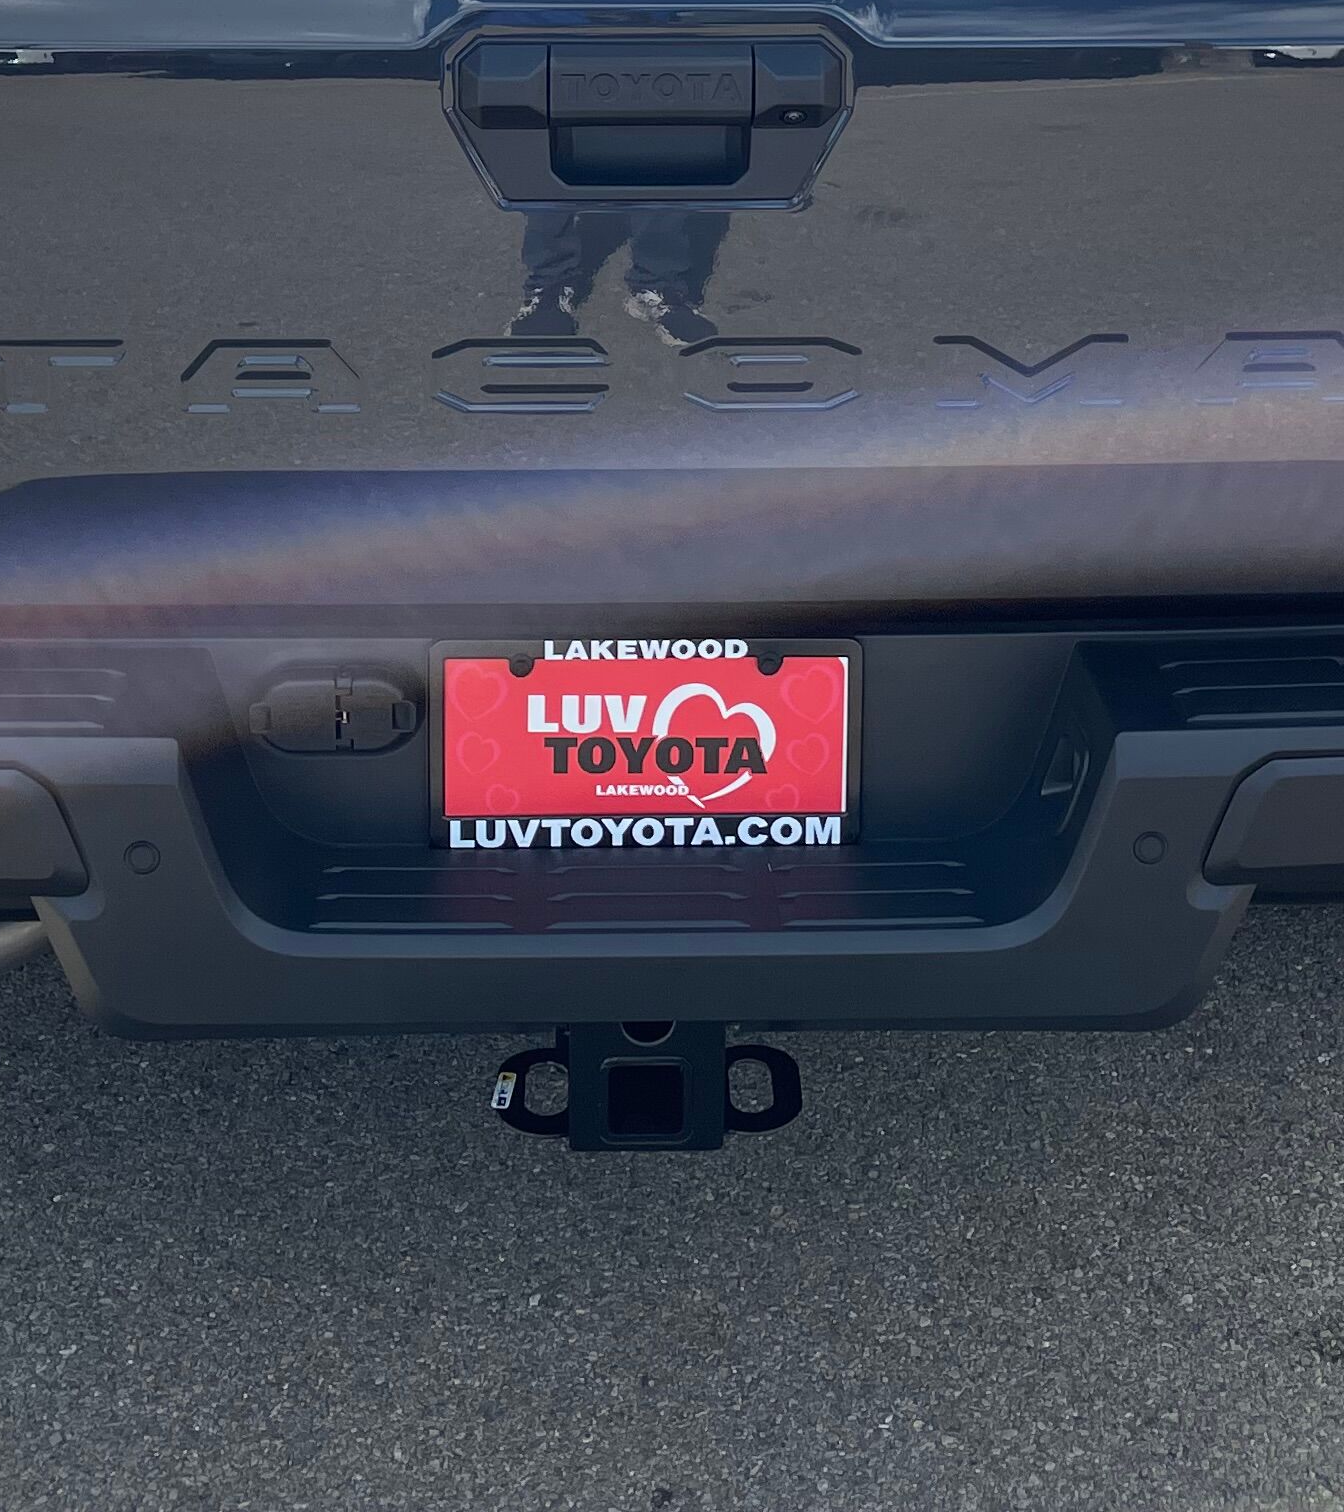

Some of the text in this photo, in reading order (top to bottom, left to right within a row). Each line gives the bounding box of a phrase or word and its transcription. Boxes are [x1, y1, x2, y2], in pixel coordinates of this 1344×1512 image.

[560, 72, 743, 102] TOYOTA
[544, 639, 749, 661] LAKEWOOD
[527, 694, 647, 734] LUV
[544, 737, 767, 775] TOYOTA
[595, 784, 690, 797] LAKEWOOD
[449, 816, 842, 849] LUVTOYOTA.COM
